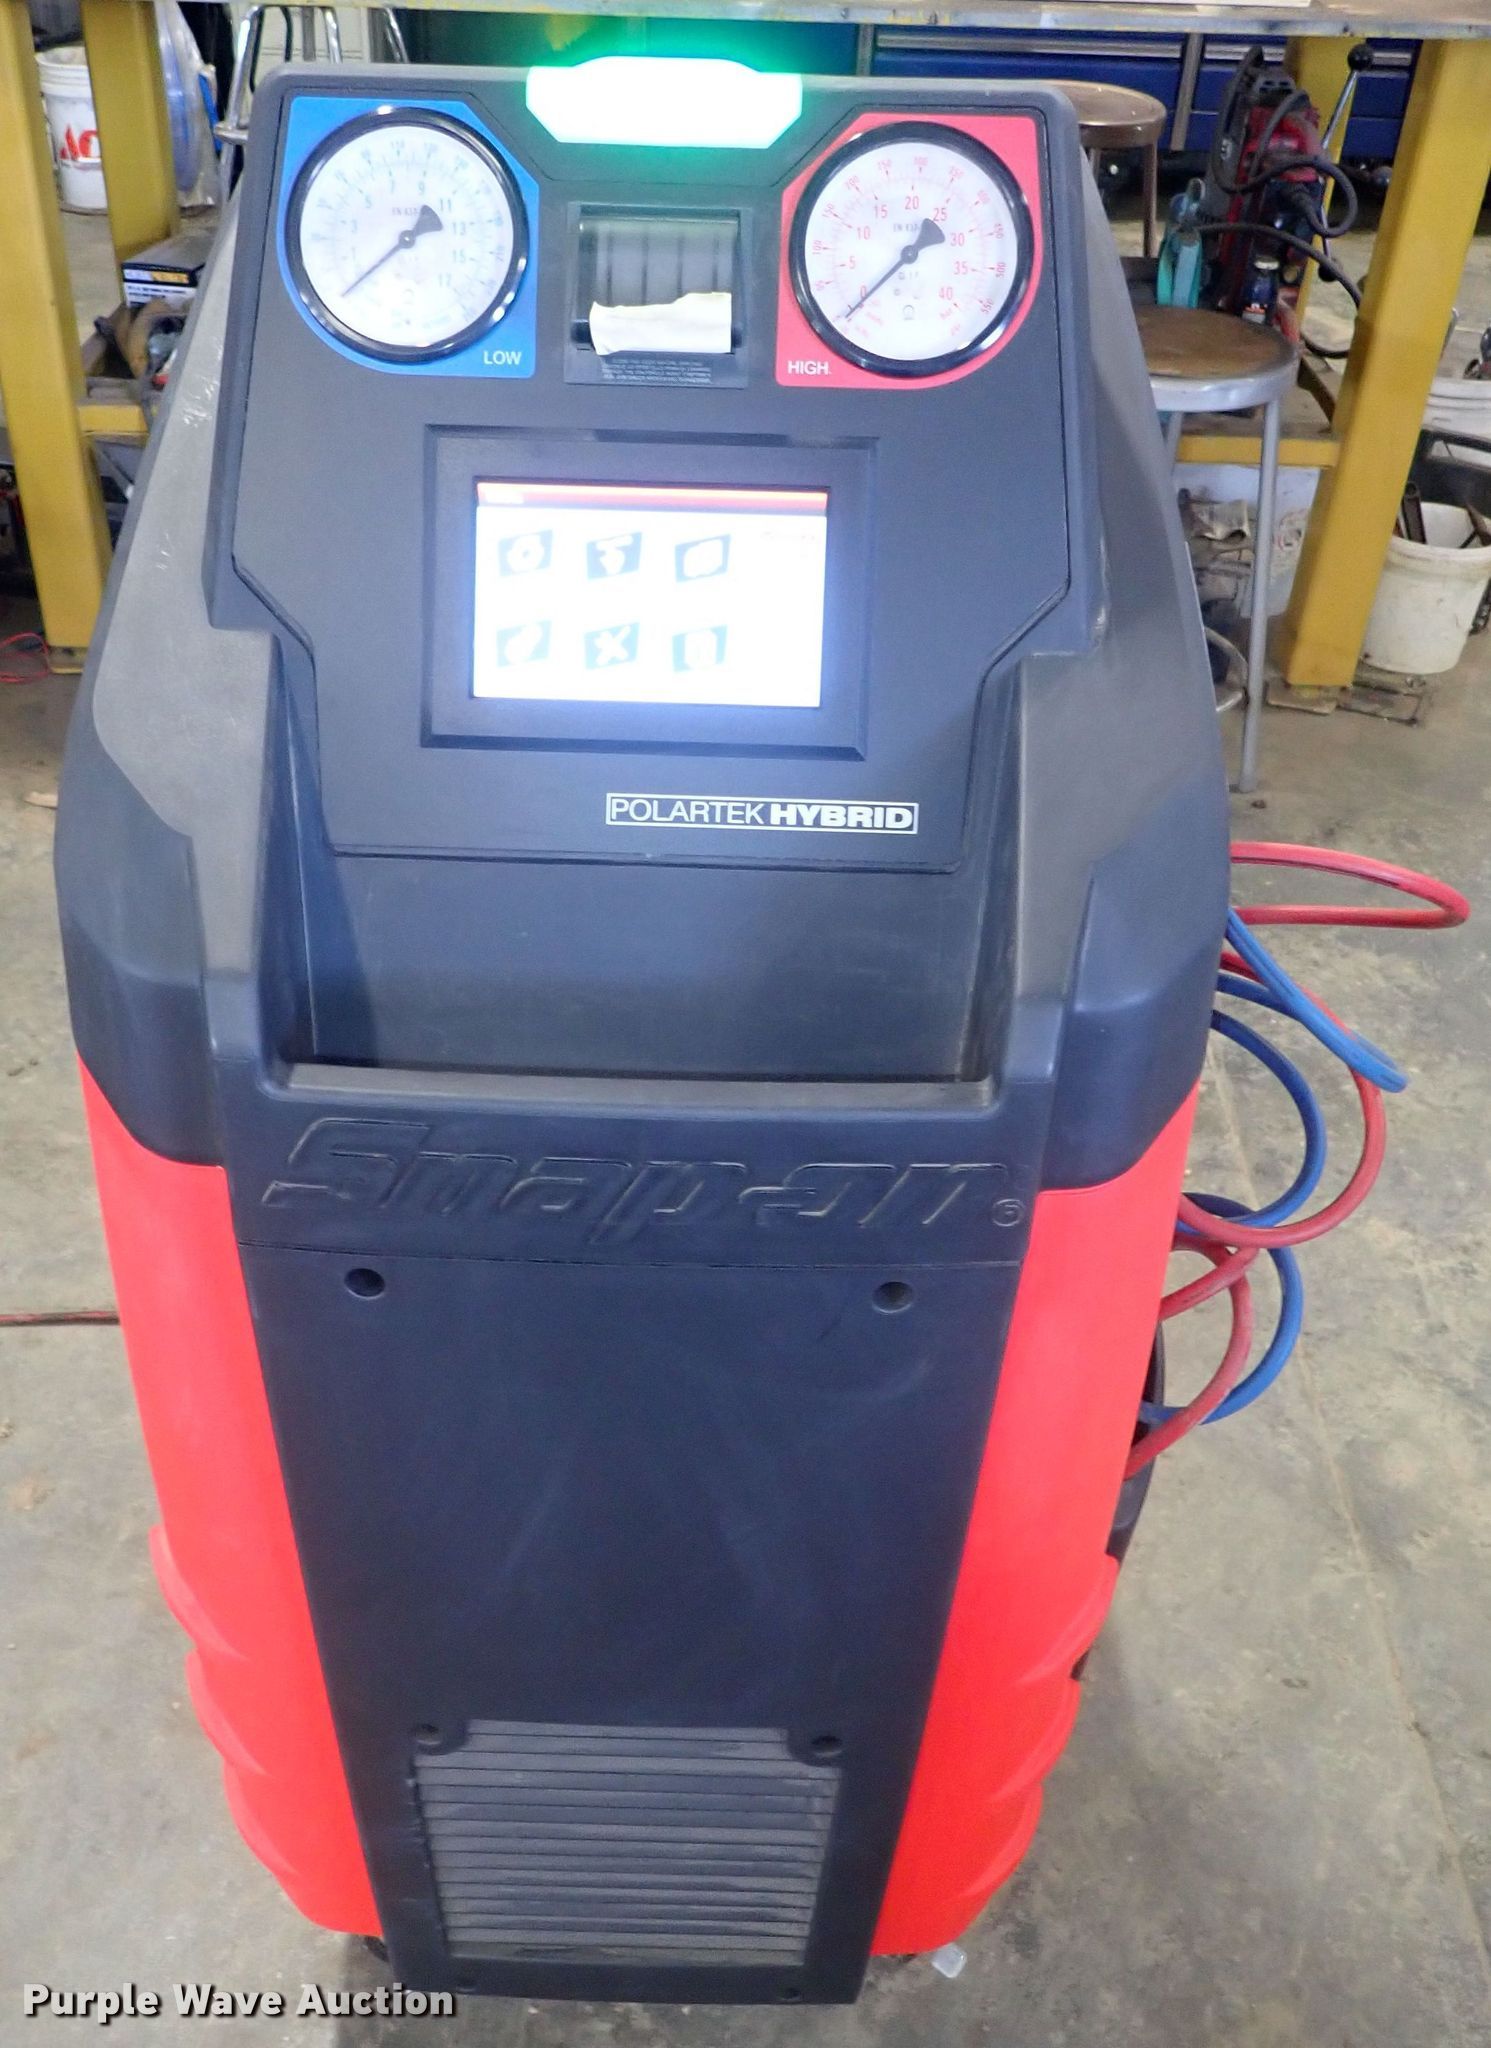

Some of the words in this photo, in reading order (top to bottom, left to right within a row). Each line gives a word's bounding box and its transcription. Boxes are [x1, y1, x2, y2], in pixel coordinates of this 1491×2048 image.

[440, 197, 453, 212] 11
[904, 196, 920, 210] 20
[873, 204, 889, 219] 15
[933, 207, 948, 222] 25
[856, 226, 871, 240] 10
[950, 232, 965, 247] 30
[848, 255, 856, 270] 5
[954, 261, 968, 276] 35
[860, 285, 867, 299] 0
[938, 286, 953, 301] 40
[483, 351, 522, 365] LOW
[787, 360, 829, 375] HIGH
[611, 798, 764, 825] POLARTEK
[770, 806, 914, 829] HYBRID
